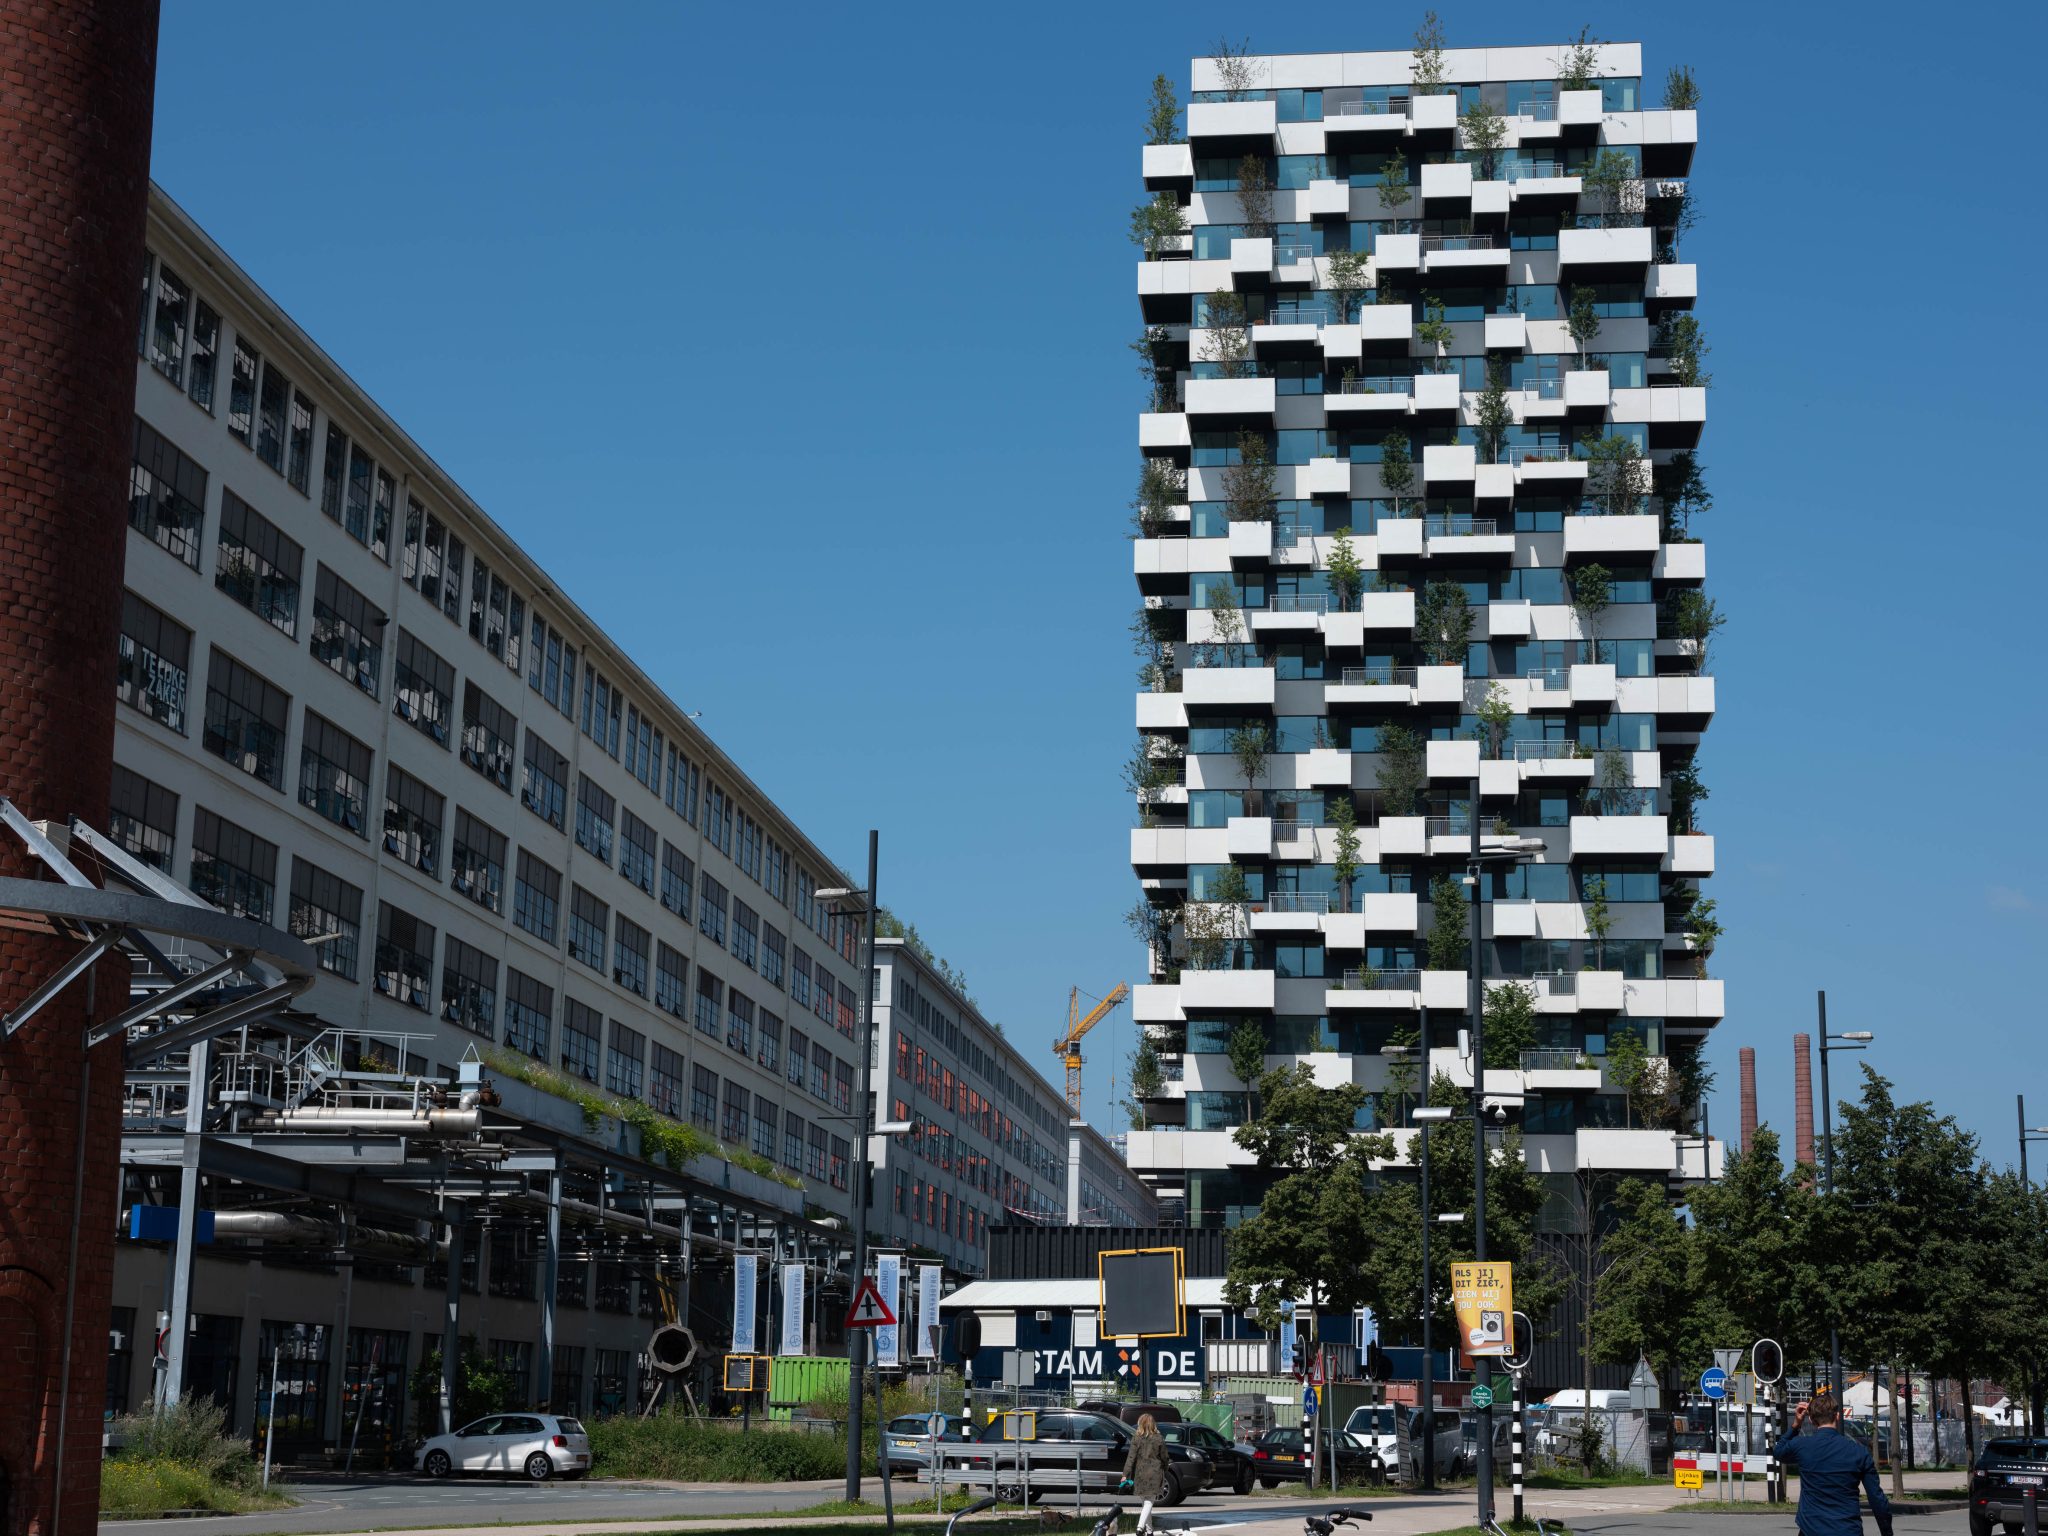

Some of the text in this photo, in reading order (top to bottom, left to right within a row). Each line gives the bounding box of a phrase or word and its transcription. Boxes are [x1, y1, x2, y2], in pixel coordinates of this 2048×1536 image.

[147, 673, 186, 713] ZAKEN
[1455, 1269, 1471, 1277] ALS
[1455, 1279, 1504, 1289] DIT ZIET,
[880, 1270, 889, 1332] ONTDEKK
[1456, 1289, 1500, 1301] ZIEN WIJ
[1457, 1301, 1472, 1311] JOU
[1158, 1350, 1196, 1376] DE
